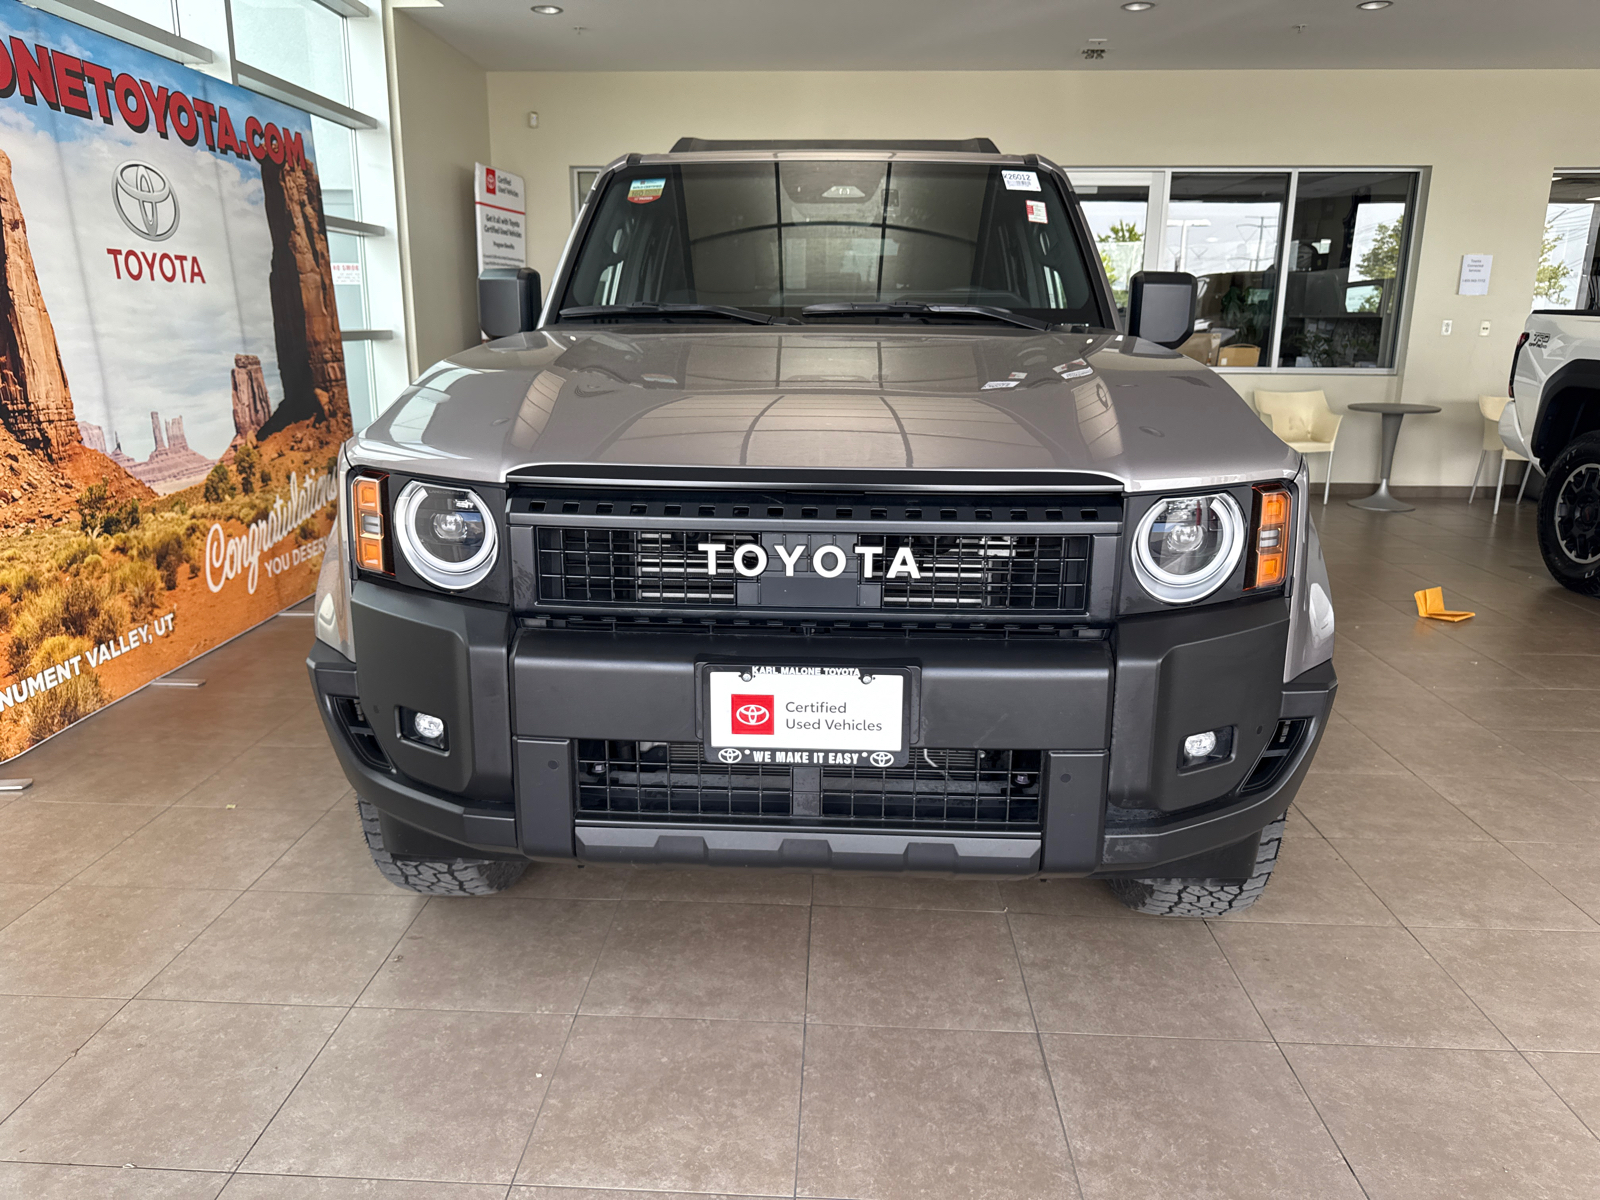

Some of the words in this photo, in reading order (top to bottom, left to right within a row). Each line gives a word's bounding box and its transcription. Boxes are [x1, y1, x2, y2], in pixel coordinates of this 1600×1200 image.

[107, 248, 206, 284] TOYOTA
[206, 466, 337, 594] Congratulations
[264, 551, 290, 578] YOU
[698, 543, 921, 579] TOYOTA
[85, 624, 153, 669] VALLEY,
[154, 613, 174, 636] UT
[752, 665, 778, 675] KARL
[781, 667, 821, 676] MALONE
[823, 668, 860, 677] TOYOTA
[785, 701, 847, 713] Certified
[785, 718, 821, 730] Used
[825, 719, 882, 731] Vehicles
[753, 750, 771, 762] WE
[776, 751, 809, 763] MAKE
[813, 752, 824, 764] IT
[828, 753, 859, 765] EASY
